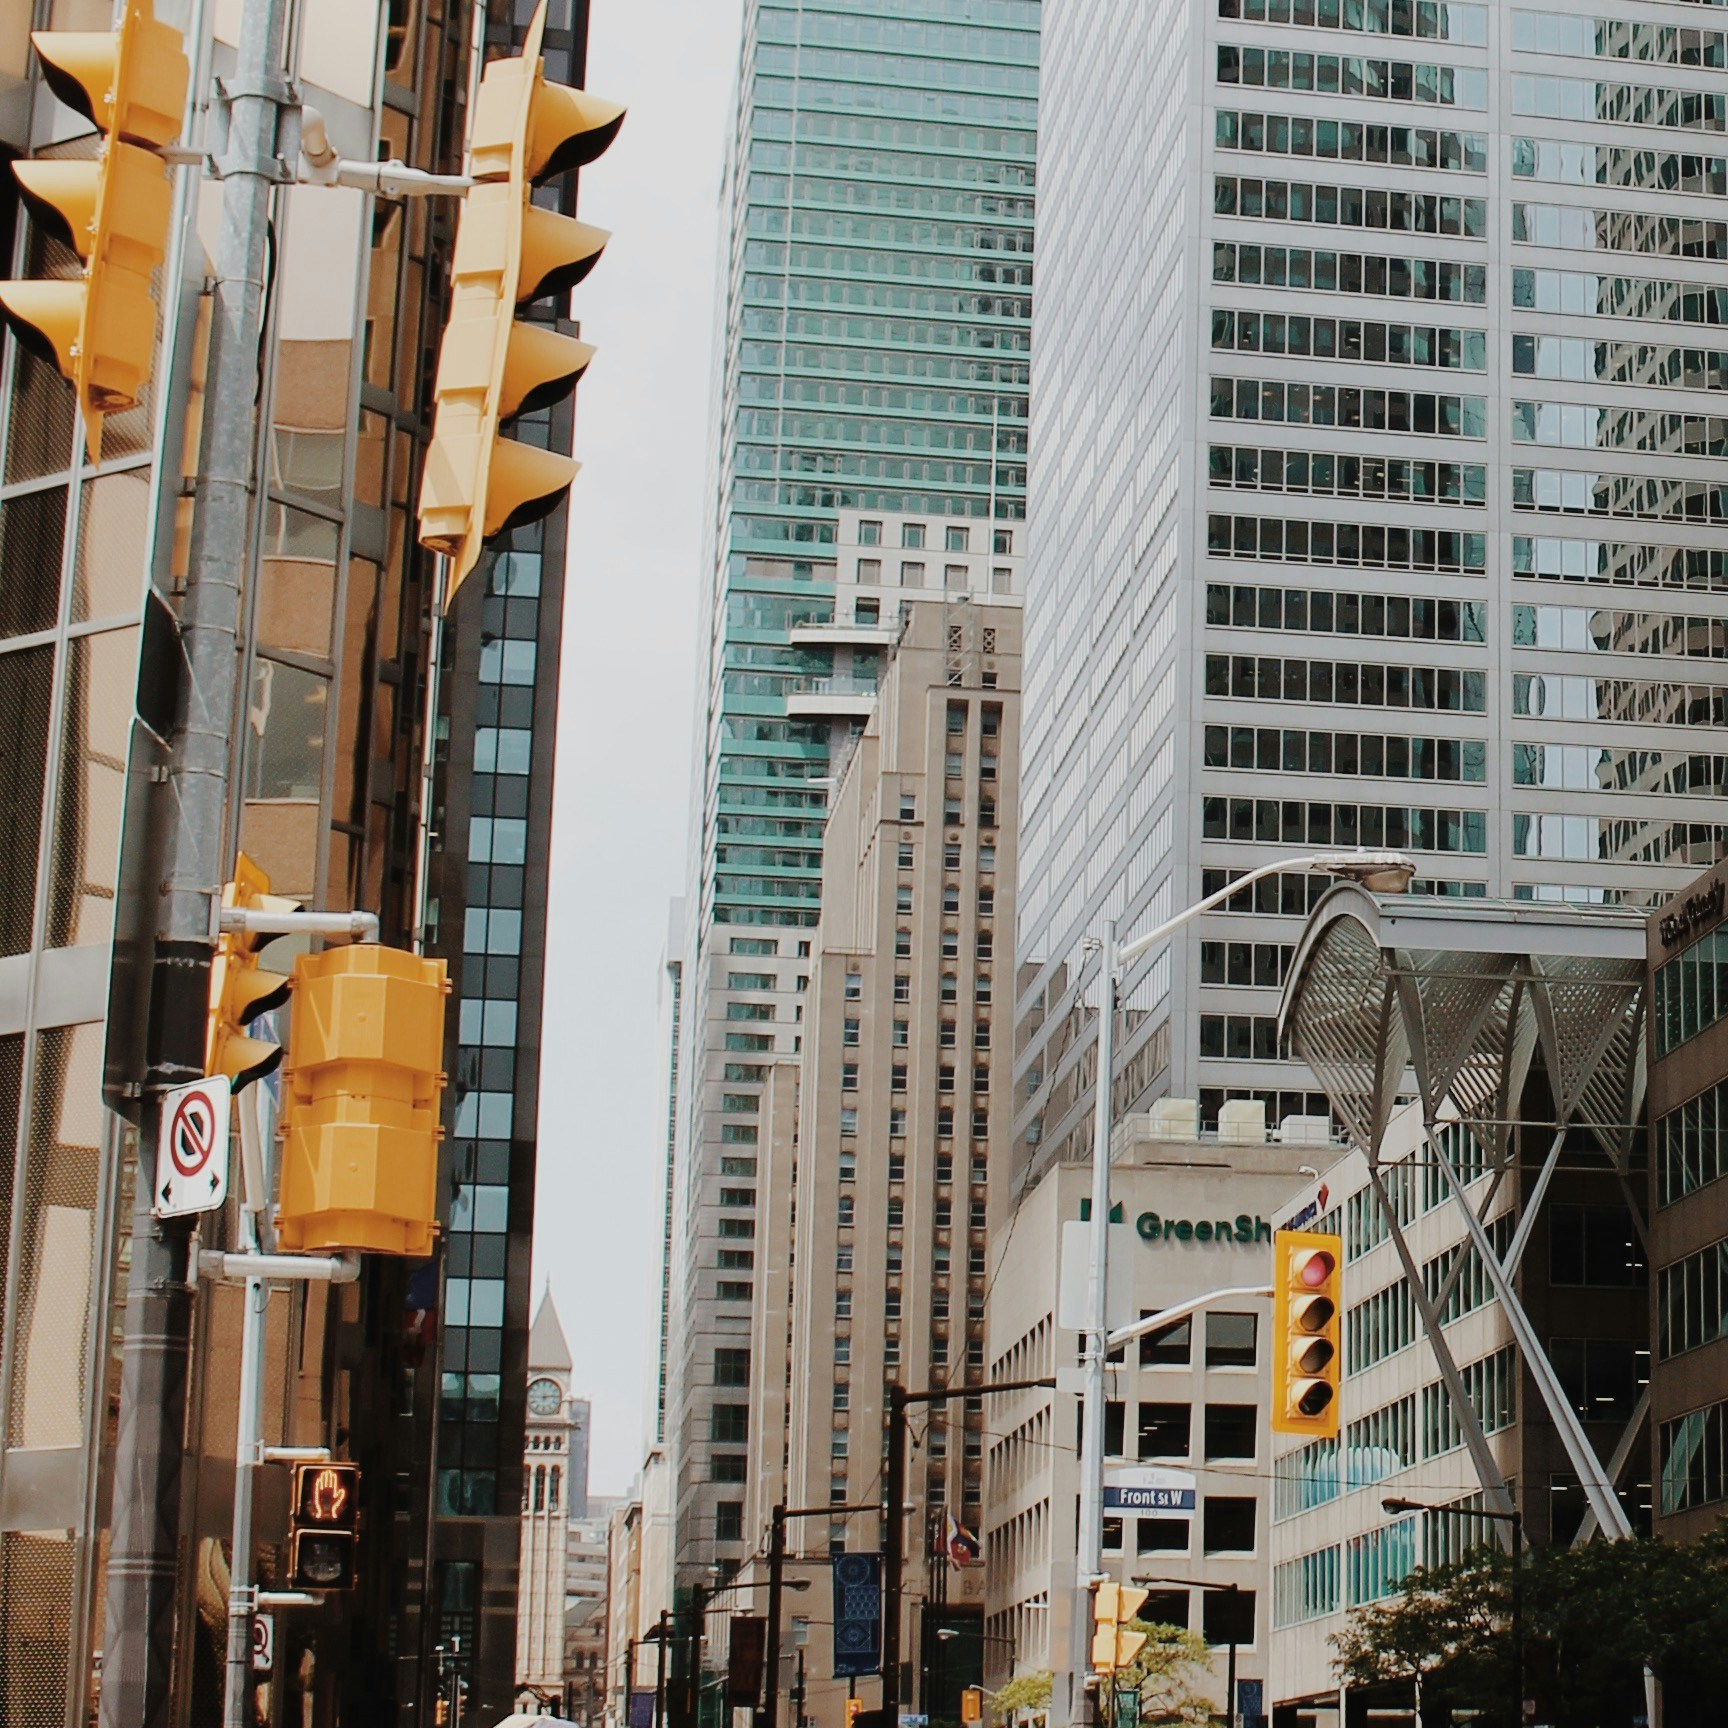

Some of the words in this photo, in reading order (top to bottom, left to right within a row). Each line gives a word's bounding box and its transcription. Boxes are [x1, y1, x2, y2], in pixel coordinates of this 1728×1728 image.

[1120, 1489, 1156, 1505] Front
[1158, 1493, 1169, 1506] St
[1170, 1490, 1183, 1506] W
